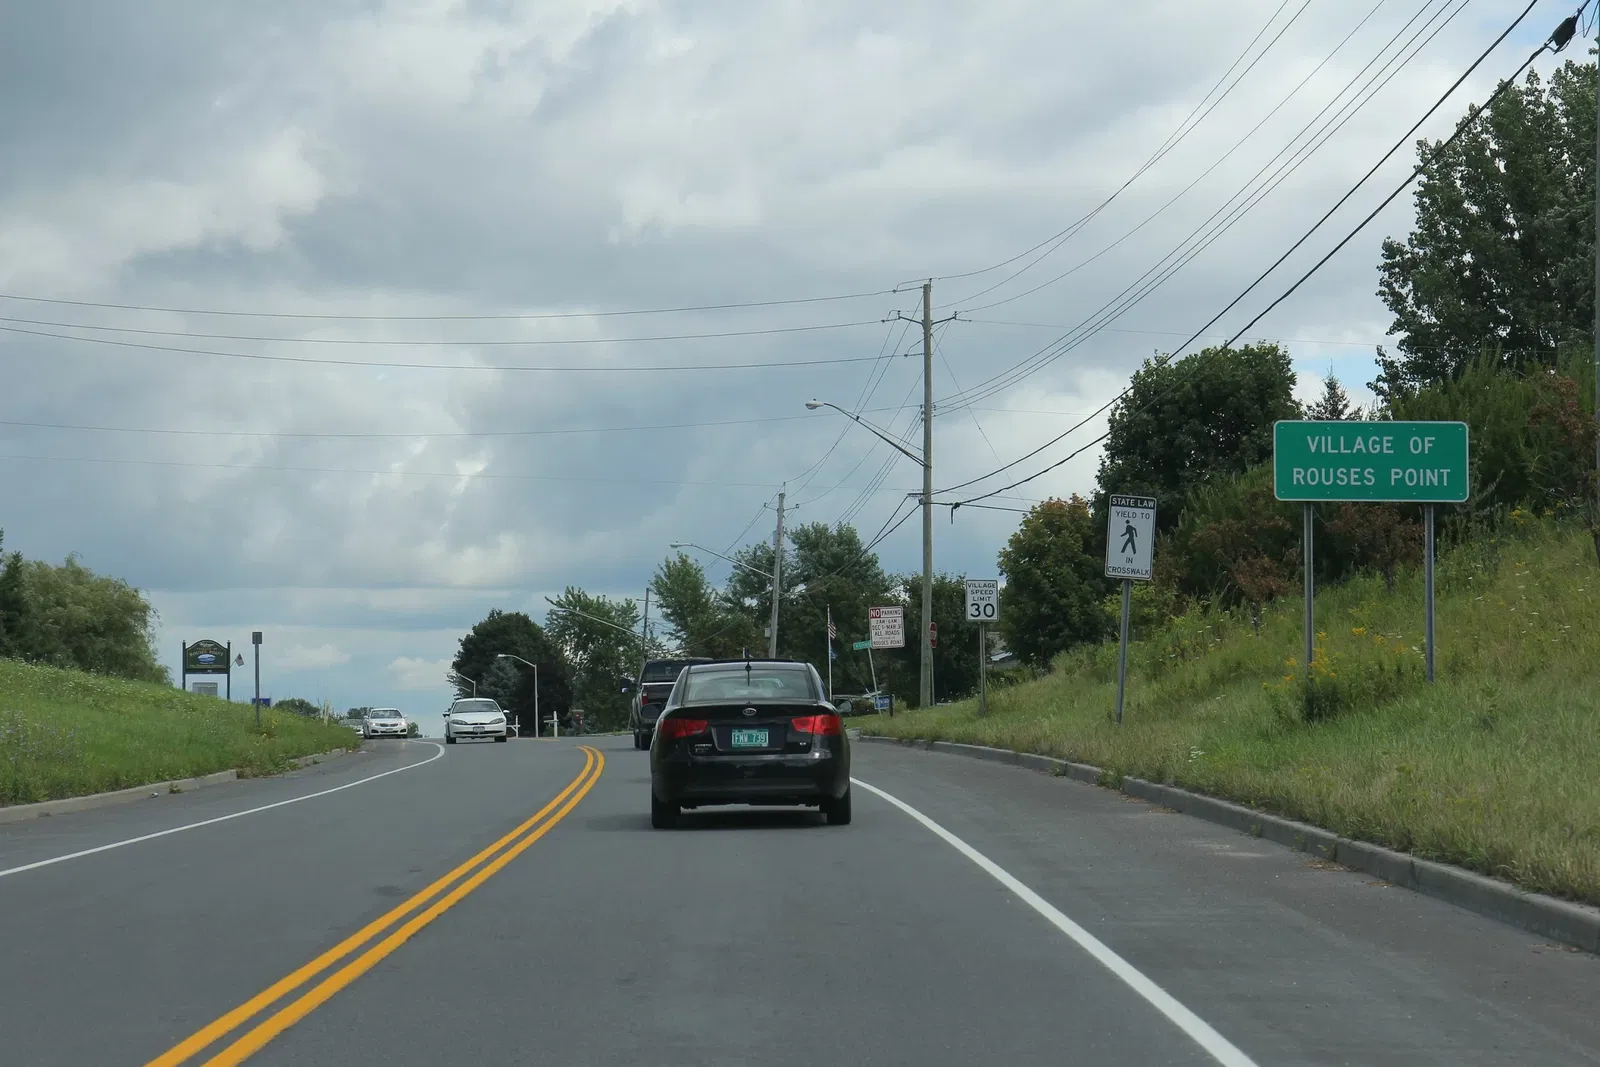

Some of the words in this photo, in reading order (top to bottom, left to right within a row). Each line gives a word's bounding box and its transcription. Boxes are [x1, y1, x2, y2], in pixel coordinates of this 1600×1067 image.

[1306, 435, 1394, 454] VILLAGE
[1409, 436, 1436, 454] OF
[1292, 467, 1375, 486] ROUSES
[1390, 468, 1451, 486] POINT
[1112, 497, 1135, 506] STATE
[1138, 499, 1155, 508] LAW
[1115, 510, 1137, 519] YIELD
[1141, 512, 1150, 520] TO
[1125, 556, 1133, 564] IN
[1107, 566, 1150, 575] CROSSWALK
[870, 609, 880, 618] NO
[881, 608, 901, 616] PARKING
[970, 603, 995, 618] 30
